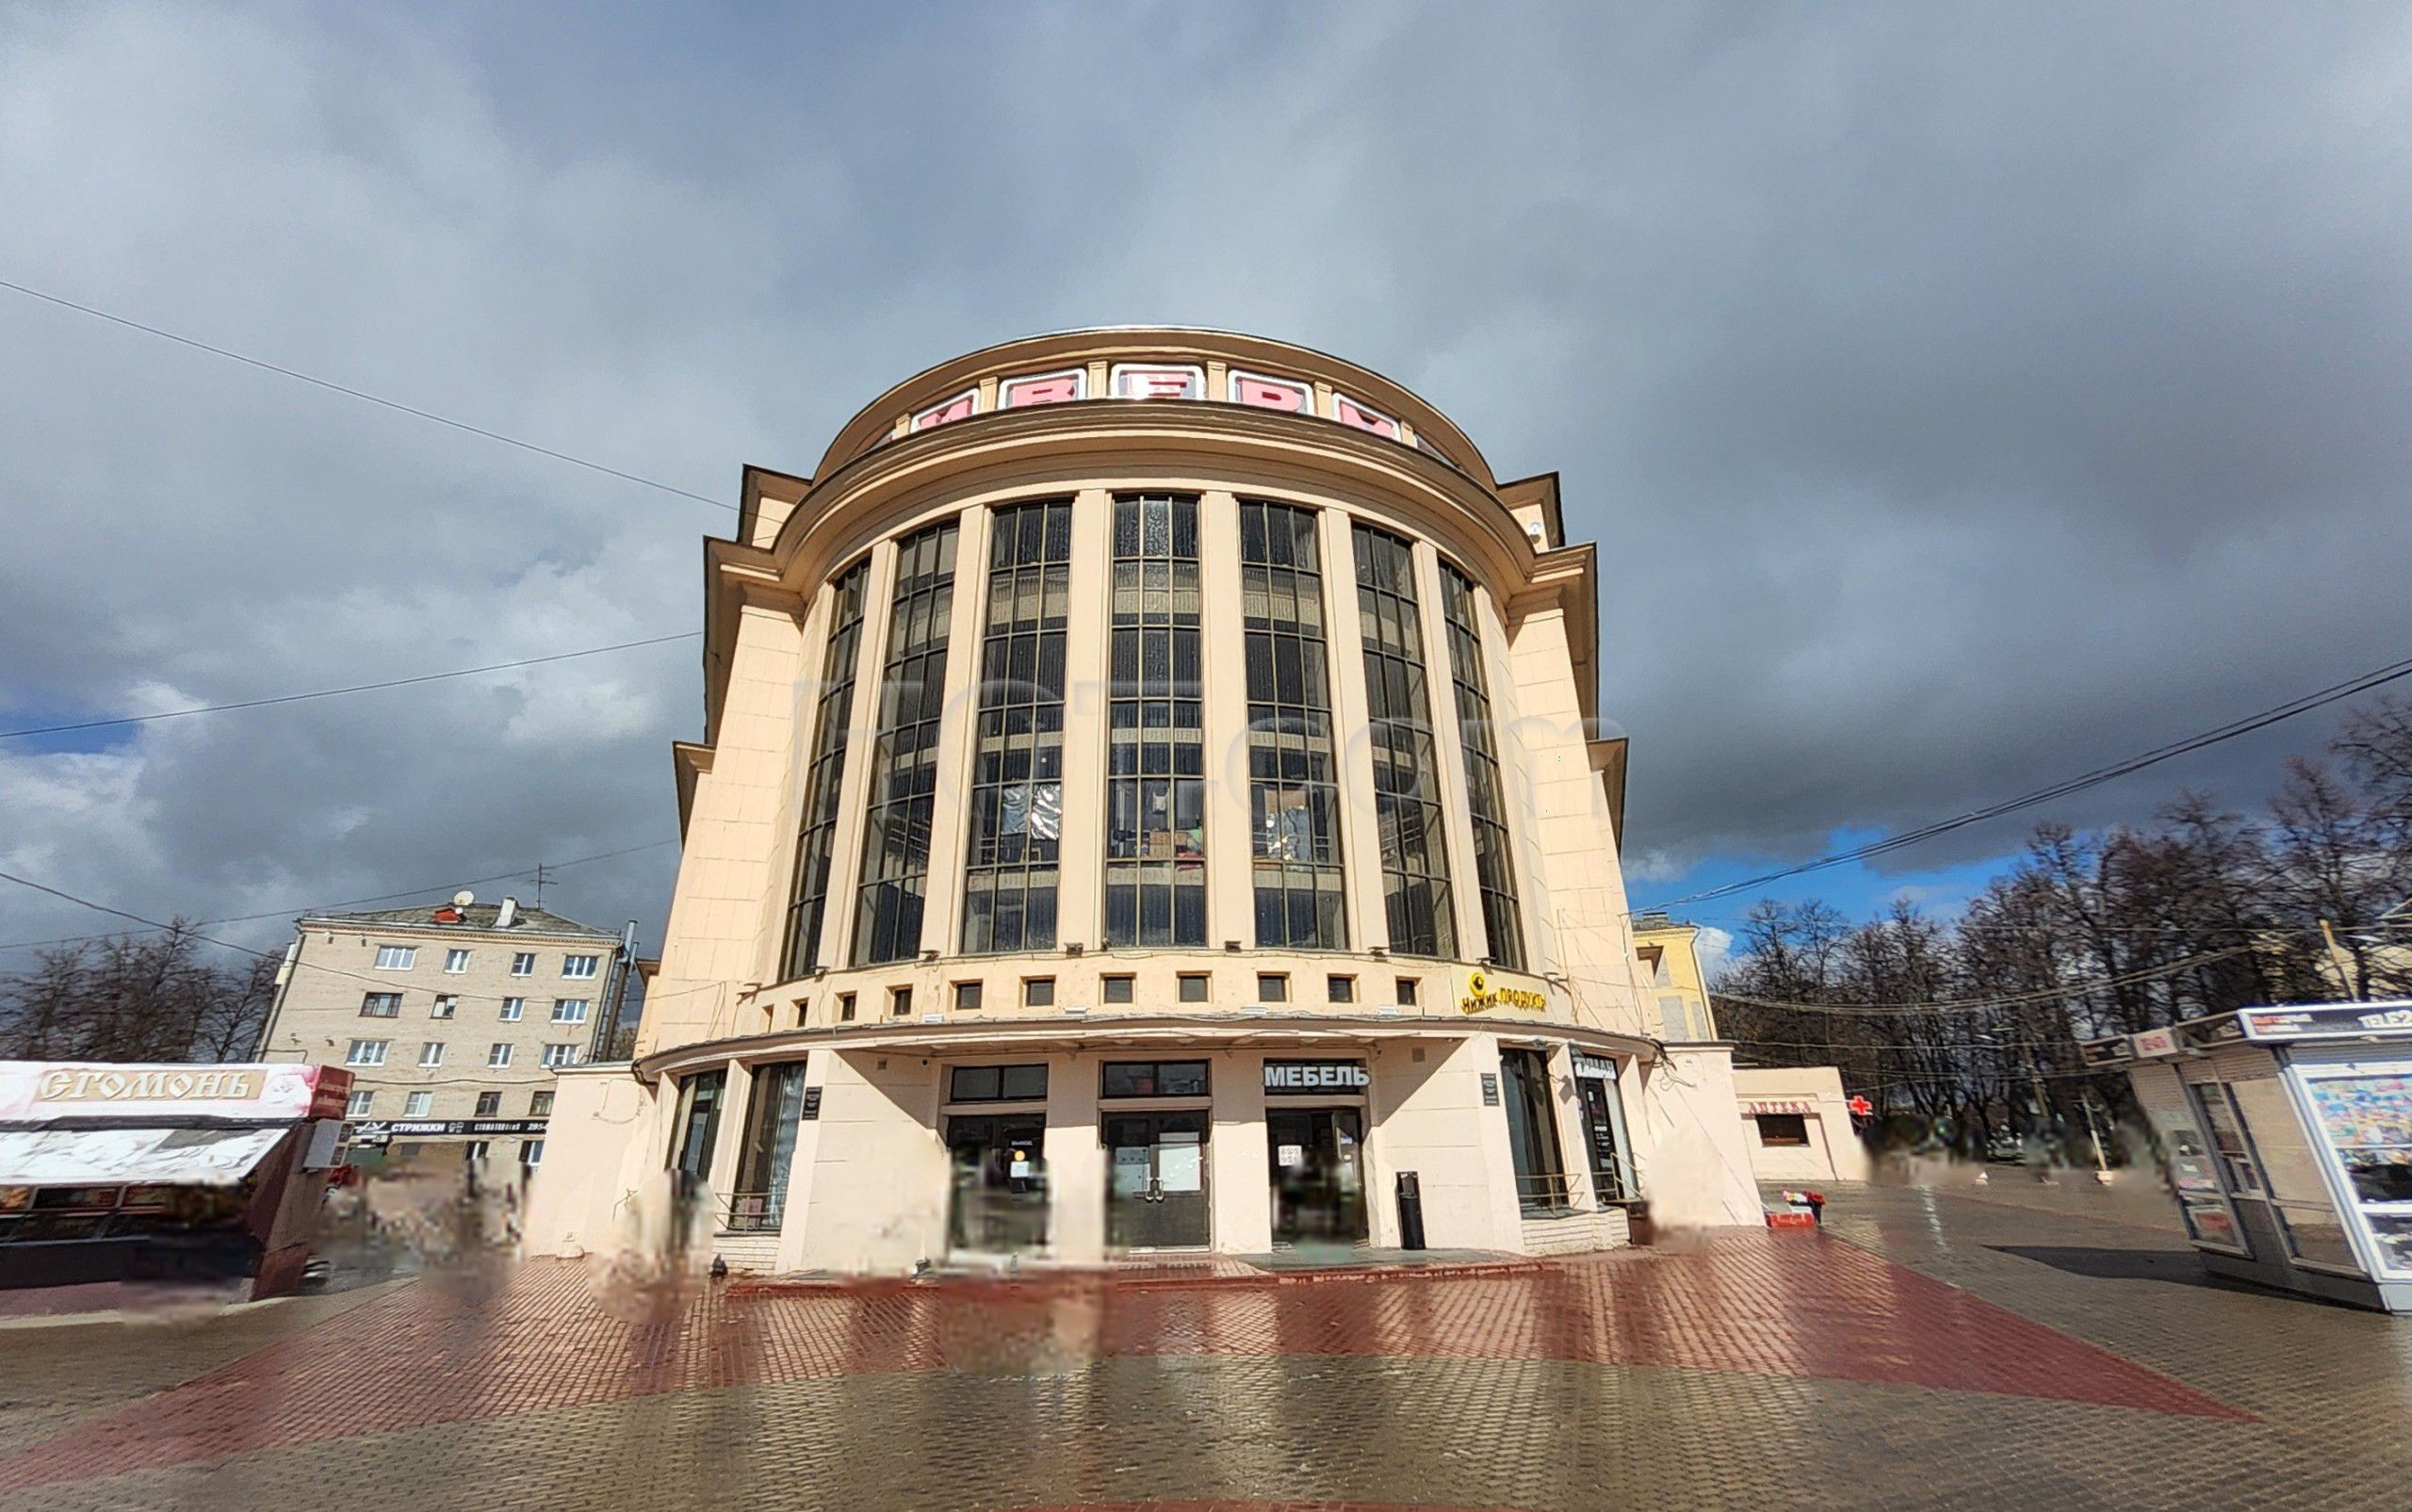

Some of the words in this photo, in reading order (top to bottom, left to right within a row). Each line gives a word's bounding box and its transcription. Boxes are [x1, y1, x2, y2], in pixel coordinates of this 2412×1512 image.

[1263, 1065, 1370, 1087] МЕБЕЛЬ
[1748, 1100, 1811, 1114] АПТЕКА
[390, 1122, 447, 1132] СТРИЖКИ
